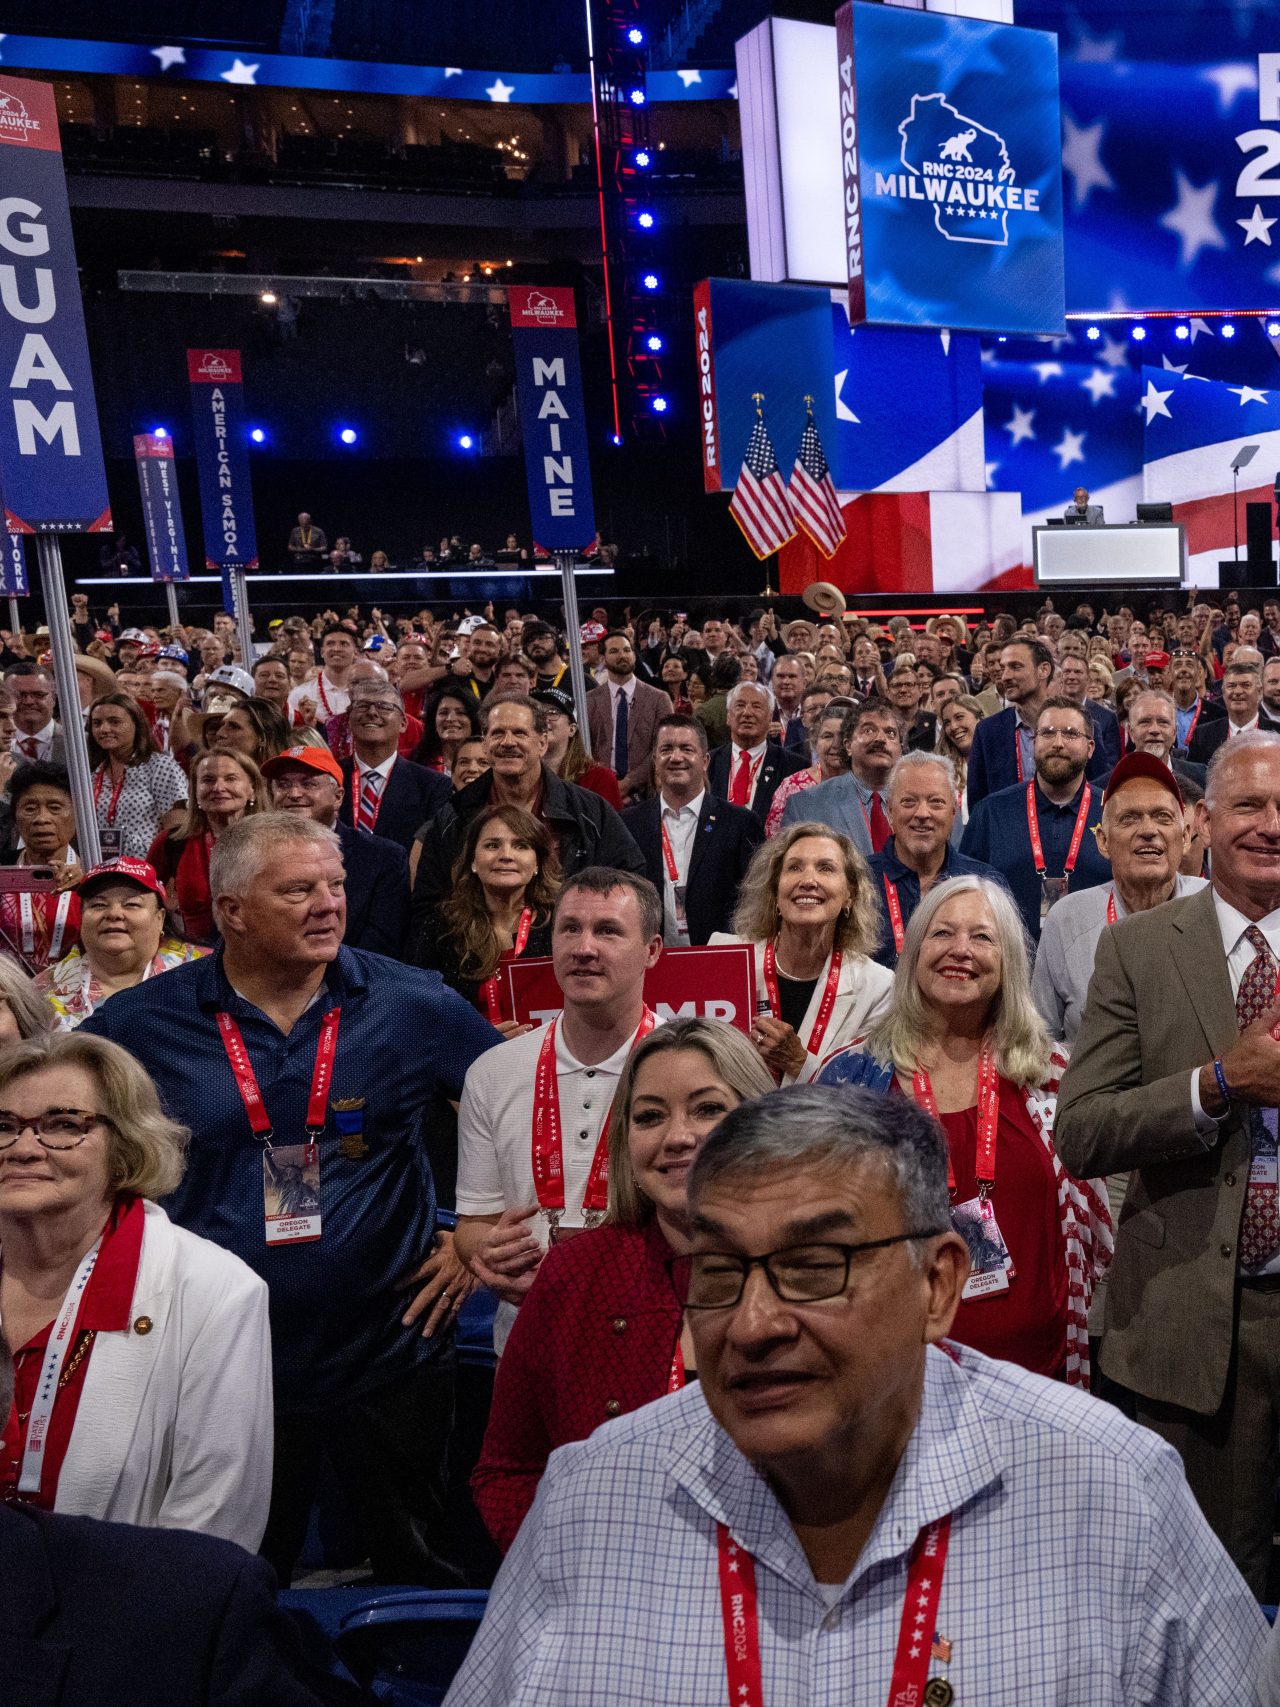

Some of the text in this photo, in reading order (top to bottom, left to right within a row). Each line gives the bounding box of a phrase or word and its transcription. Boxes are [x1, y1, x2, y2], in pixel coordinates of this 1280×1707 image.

[0, 116, 40, 130] AUKEE
[840, 54, 862, 279] RNC 2024
[922, 161, 994, 182] RNC 2024
[875, 172, 1041, 212] MILWAUKEE
[0, 196, 82, 457] GUAM
[697, 306, 716, 468] RNC 2024
[532, 357, 576, 517] MAINE
[158, 460, 171, 497] WEST
[211, 388, 232, 488] AMERICAN
[222, 494, 239, 556] SAMOA
[164, 500, 181, 573] VIRGINIA
[10, 535, 25, 590] YORK
[116, 865, 147, 876] AGAIN
[323, 1026, 333, 1054] RNC2024
[536, 1107, 544, 1136] RNC2024
[276, 1224, 311, 1233] DELEGATE
[279, 1219, 308, 1227] OREGON
[969, 1279, 999, 1290] DELEGATE
[970, 1274, 996, 1284] OREGON
[56, 1301, 76, 1341] RNC2024
[31, 1419, 40, 1440] DATA
[38, 1415, 47, 1438] TRUST
[730, 1593, 748, 1662] RNC2024
